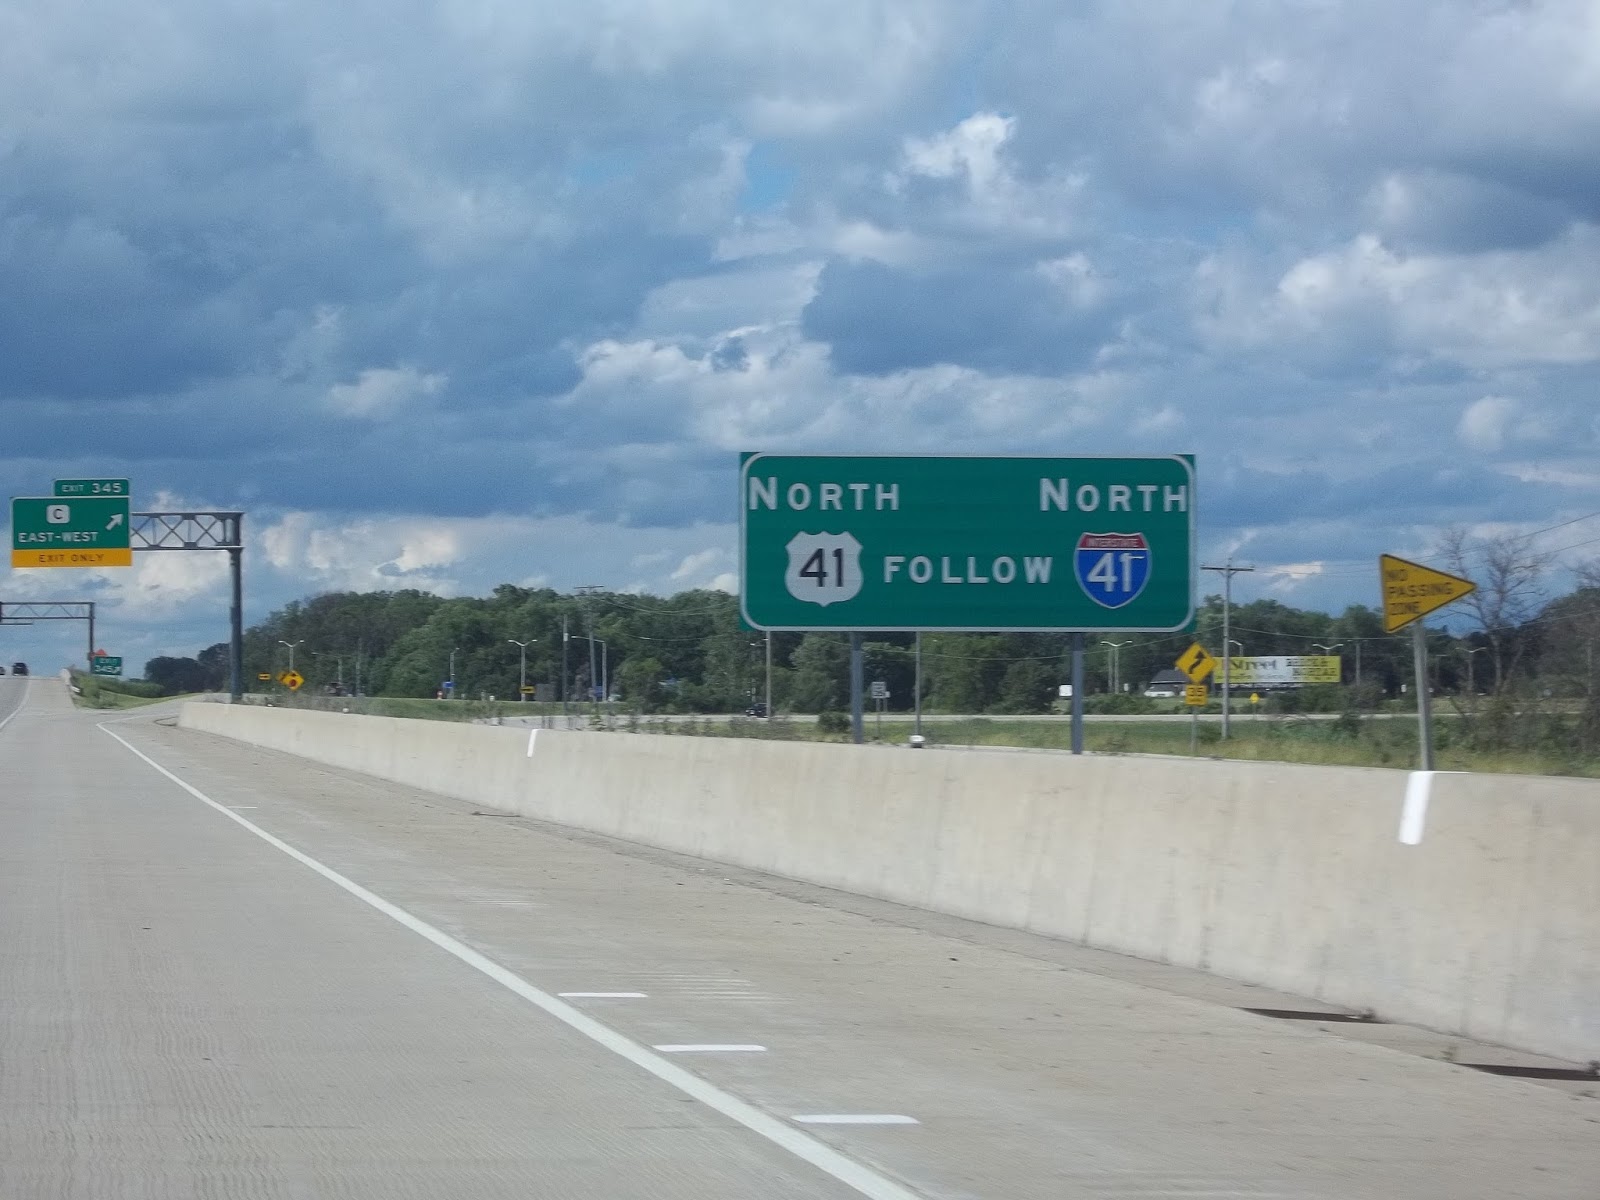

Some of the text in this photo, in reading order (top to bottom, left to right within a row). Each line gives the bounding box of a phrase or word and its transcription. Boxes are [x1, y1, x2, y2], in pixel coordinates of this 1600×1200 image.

[61, 482, 122, 493] EXIT 345
[749, 476, 900, 511] NORTH
[1039, 477, 1187, 512] NORTH
[53, 508, 64, 520] C
[18, 531, 98, 543] EAST-WEST
[39, 553, 105, 562] EXIT ONLY
[799, 548, 843, 587] 41
[883, 556, 1053, 583] FOLLOW
[1086, 552, 1133, 592] 41
[1386, 569, 1408, 582] NO
[1388, 582, 1453, 598] PASSING
[1389, 601, 1420, 616] ZONE
